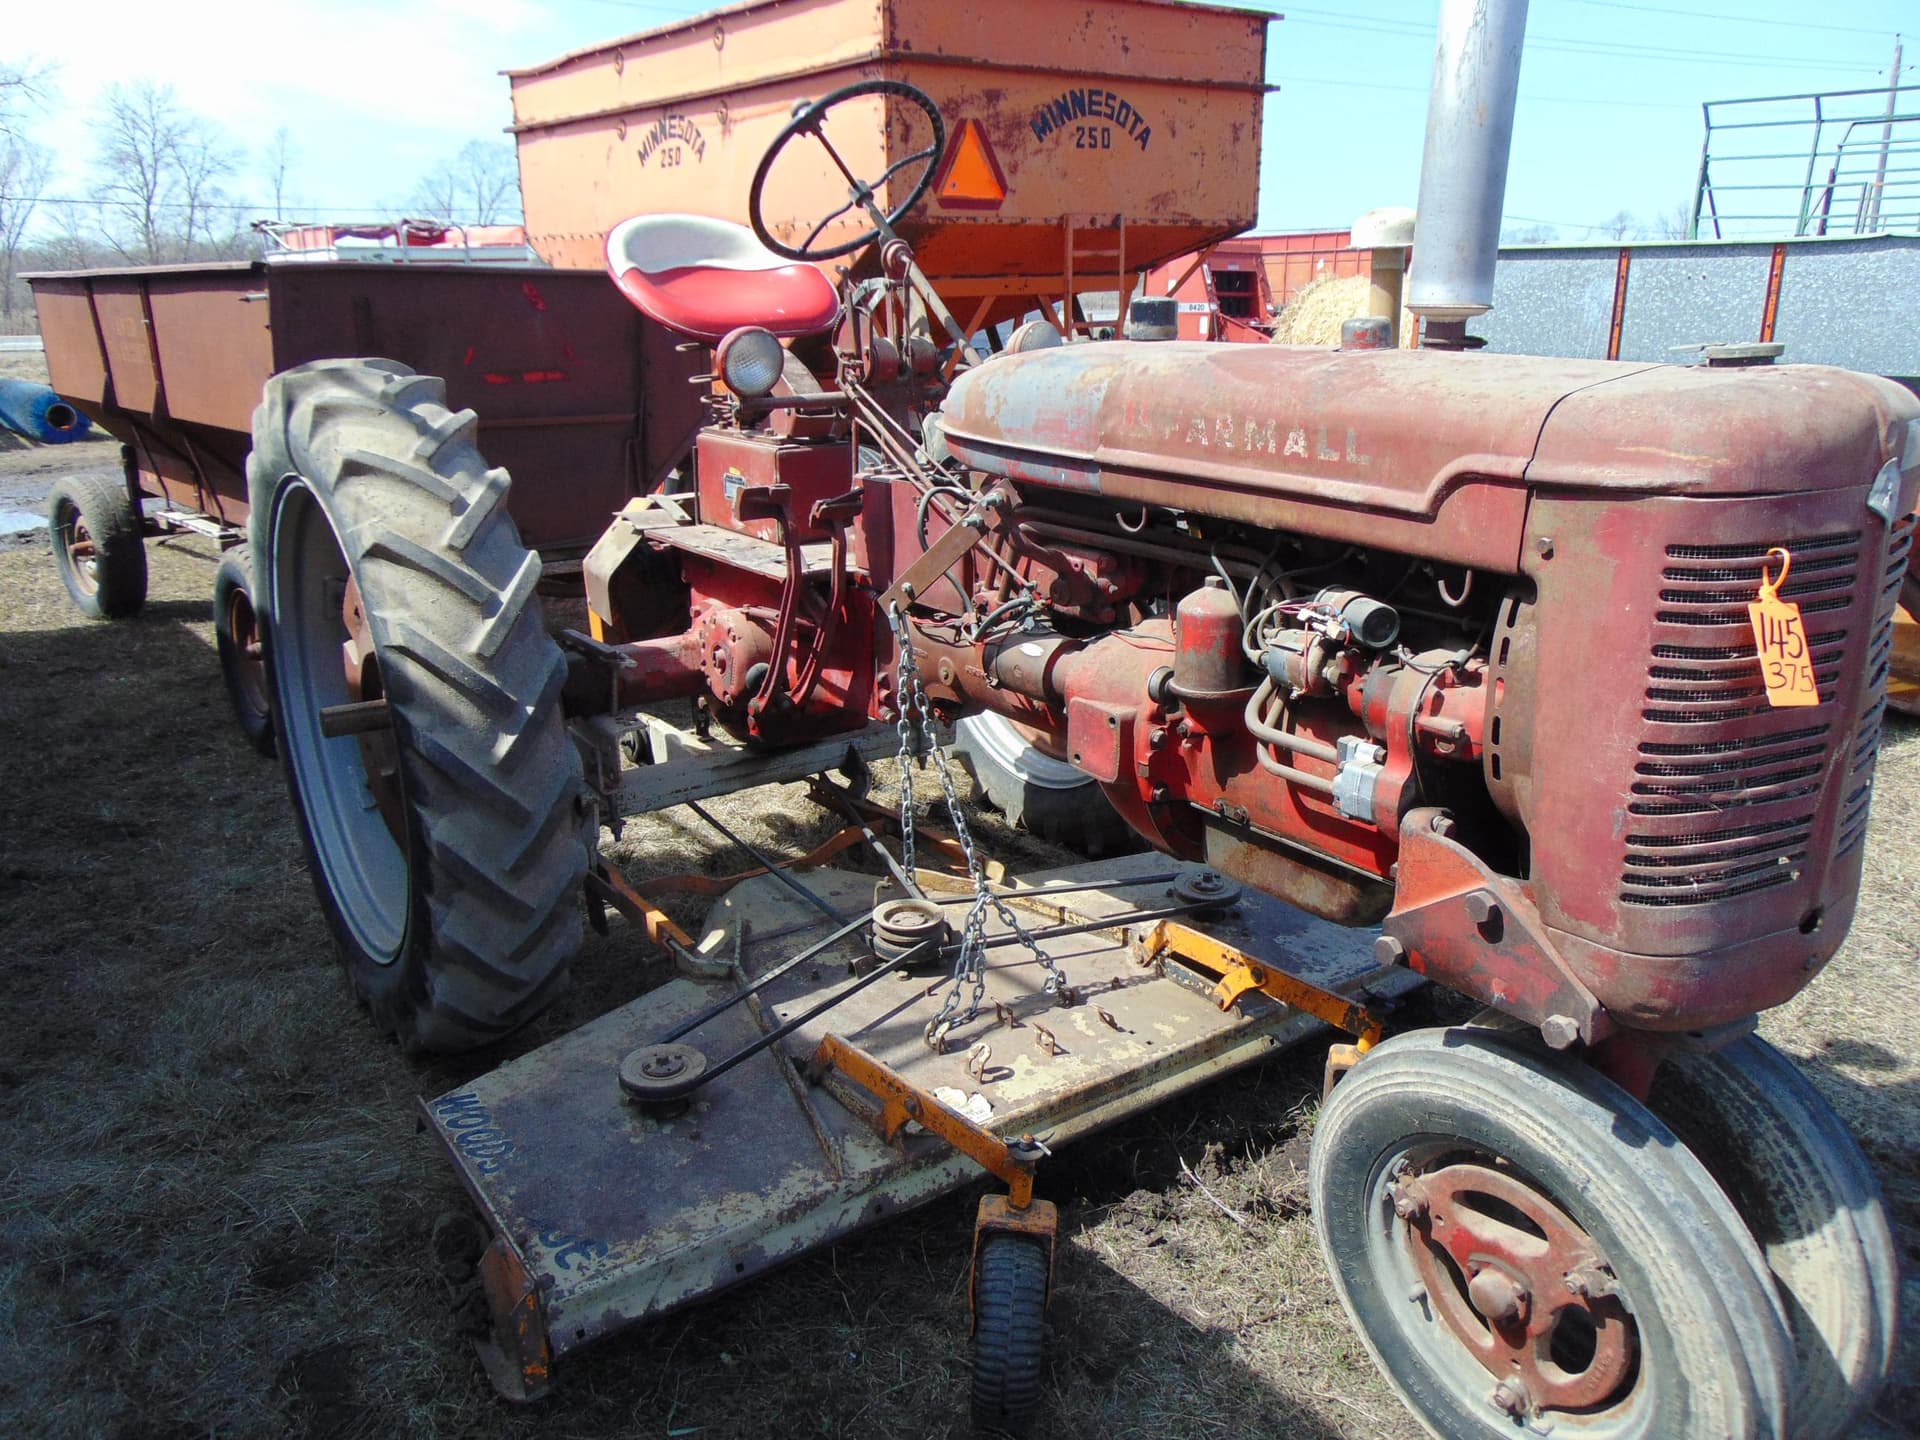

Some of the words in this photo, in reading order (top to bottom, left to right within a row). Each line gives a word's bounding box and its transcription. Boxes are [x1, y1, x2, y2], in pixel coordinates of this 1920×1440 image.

[1029, 88, 1151, 151] MINNESOTA
[1076, 126, 1111, 149] 250
[637, 114, 706, 168] MINNESOTA
[660, 146, 681, 168] 250
[1760, 612, 1804, 660] 145
[1767, 661, 1815, 693] 375
